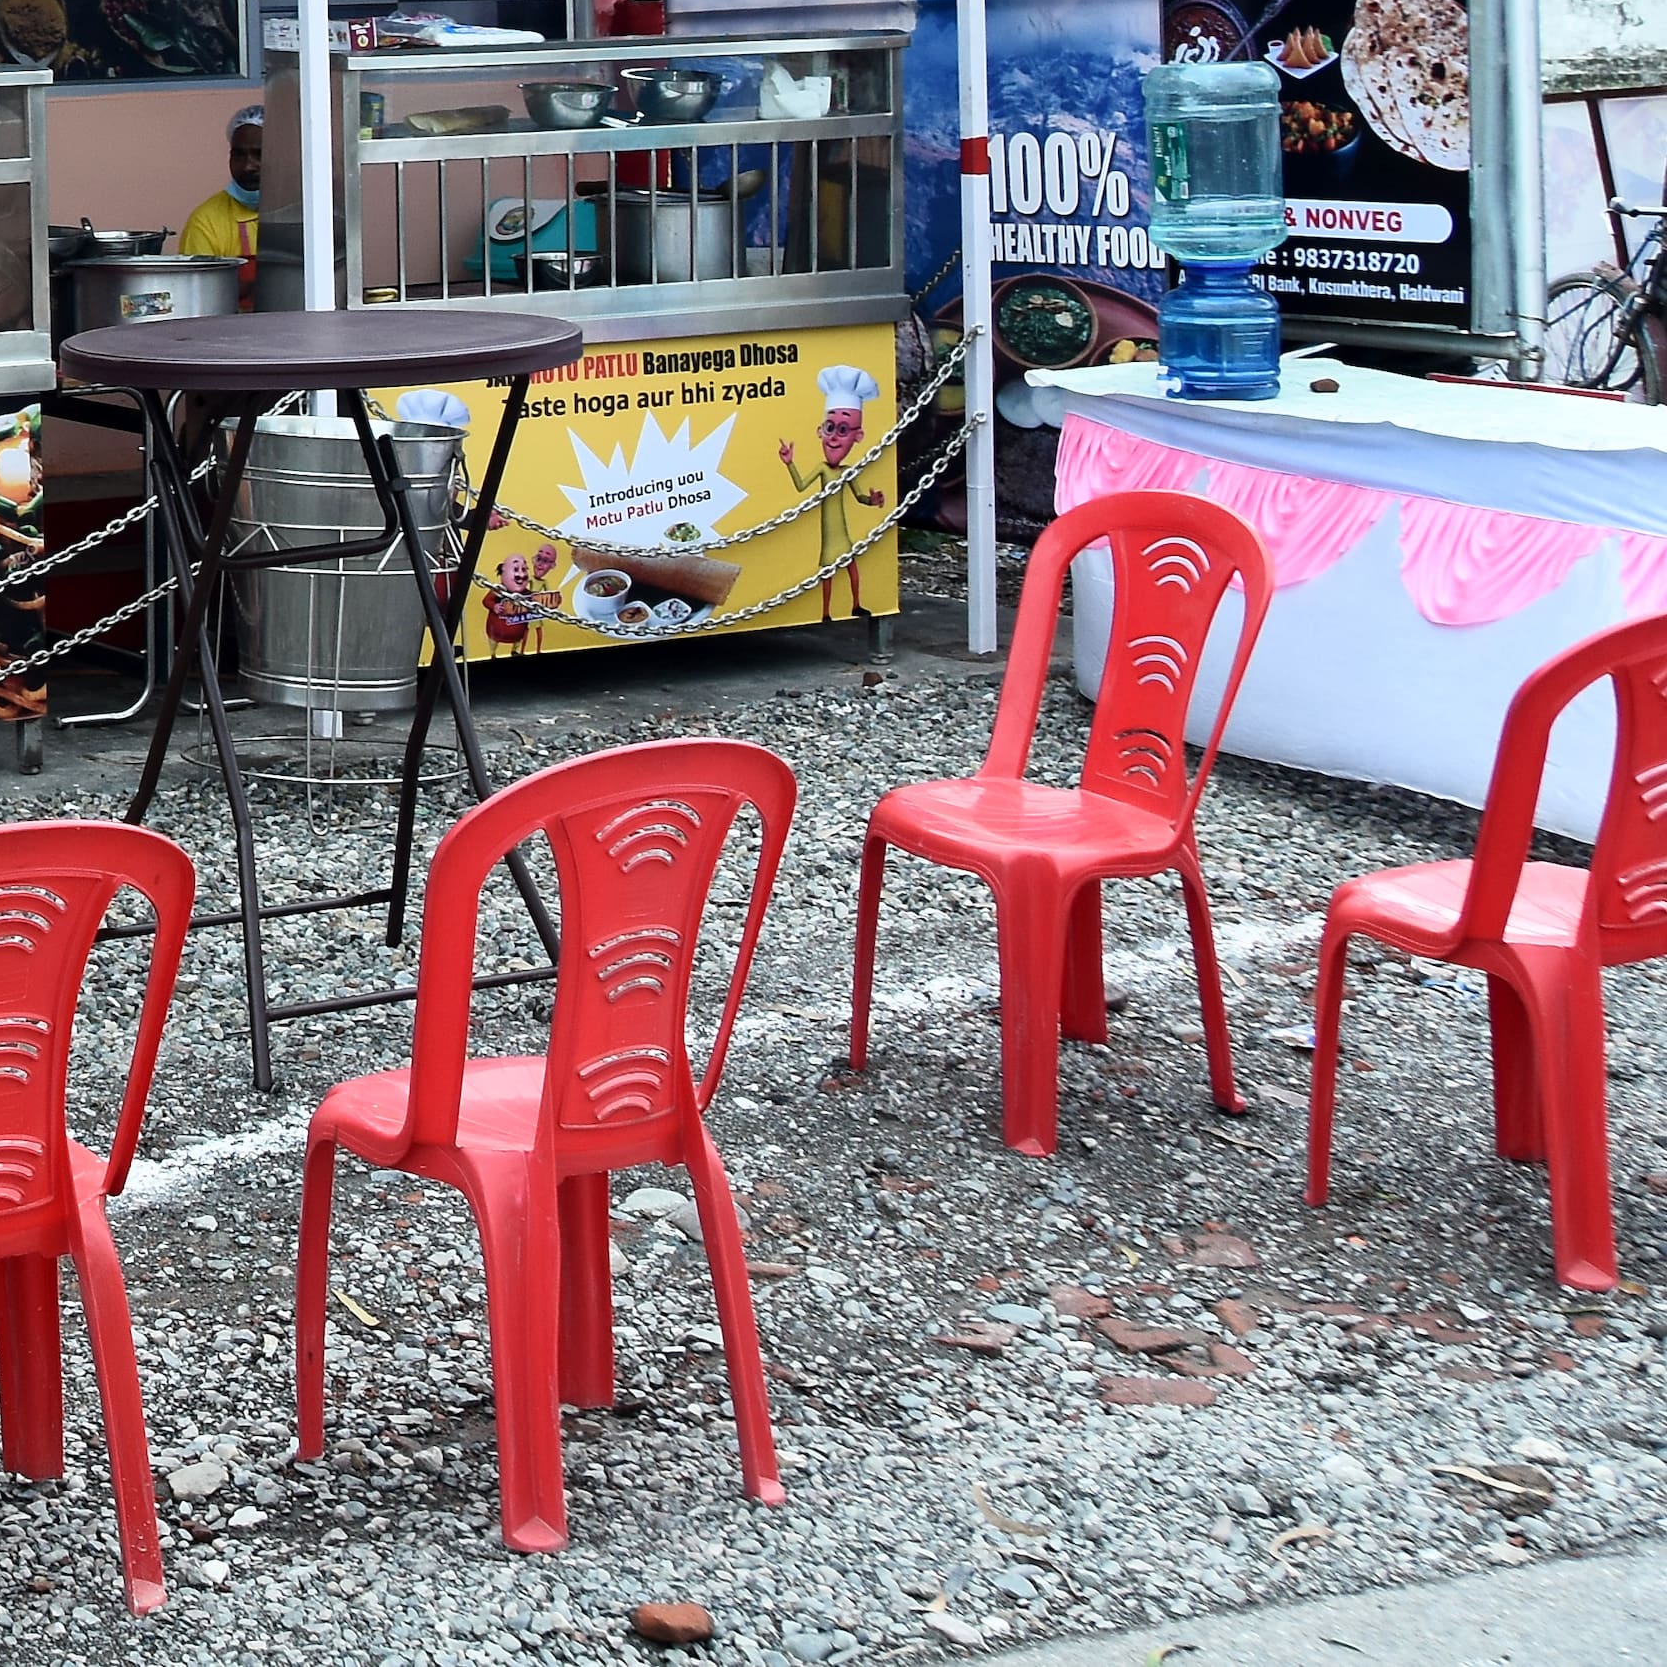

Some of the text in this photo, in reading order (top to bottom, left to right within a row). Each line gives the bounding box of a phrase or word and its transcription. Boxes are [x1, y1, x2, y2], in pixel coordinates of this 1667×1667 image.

[988, 131, 1131, 217] 100%
[1283, 206, 1403, 233] & NONVEG
[990, 223, 1091, 266] HEALTHY
[1294, 247, 1421, 275] 9837318720
[1268, 275, 1306, 296] Bank,
[1309, 277, 1397, 301] Kusumkhera,
[1399, 283, 1465, 305] Haldwani
[584, 352, 639, 381] PATLU
[643, 347, 736, 375] Banayega
[740, 343, 799, 367] Dhosa
[503, 375, 786, 419] aste hoga aur bhi zyada
[586, 489, 711, 530] Motu Patlu Dhosa
[588, 476, 674, 509] Introducing
